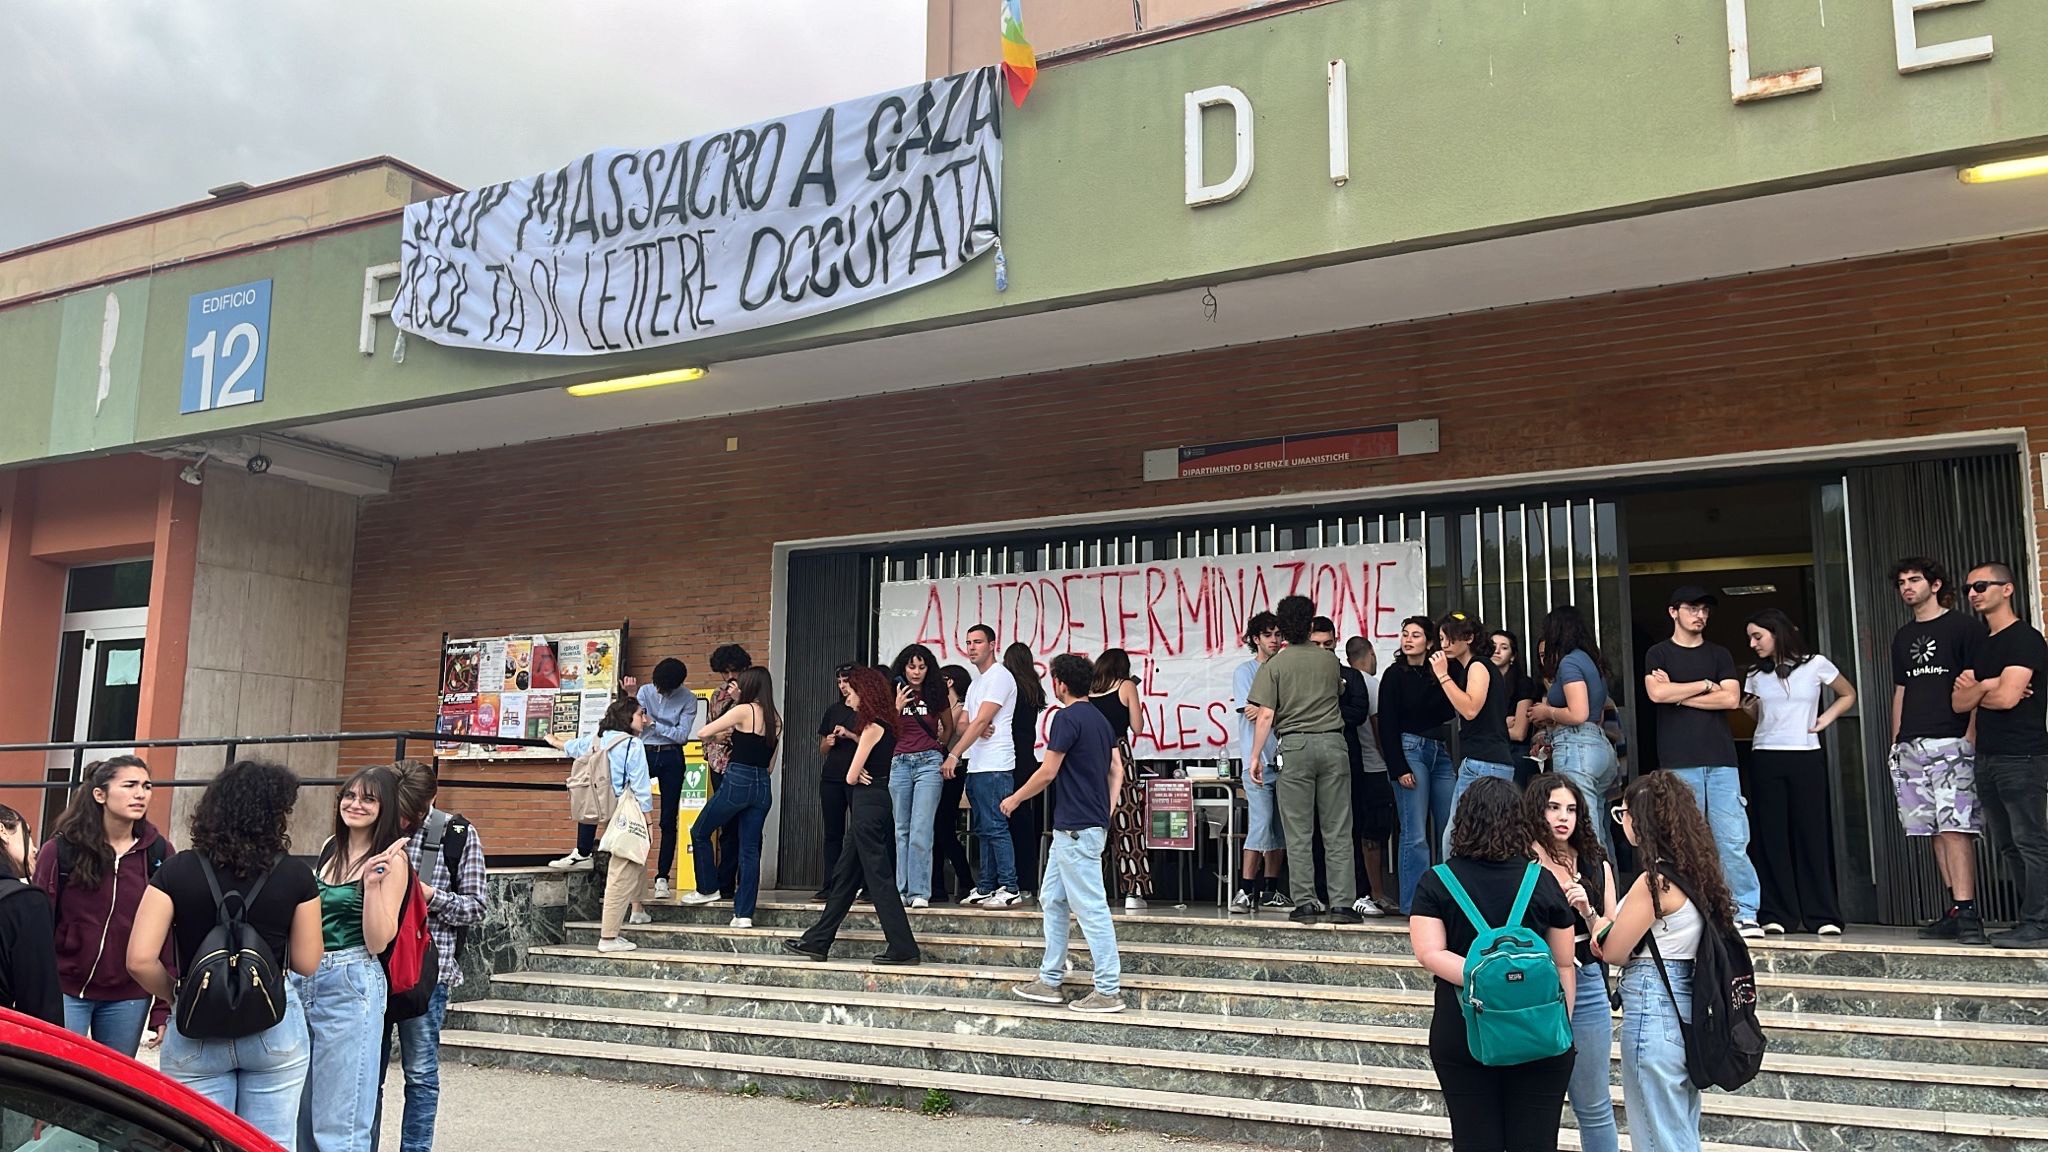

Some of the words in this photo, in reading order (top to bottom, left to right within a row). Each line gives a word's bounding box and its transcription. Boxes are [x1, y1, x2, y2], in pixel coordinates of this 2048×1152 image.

[517, 122, 787, 251] MASSACRO
[789, 107, 836, 207] A
[865, 65, 1000, 181] GAZA
[1185, 58, 1349, 207] DI
[579, 230, 718, 350] LETTERE
[739, 145, 998, 310] OCCUPATA
[202, 288, 256, 314] EDIFICIO
[191, 321, 260, 410] 12
[1182, 464, 1241, 477] DIPARTIMENTO
[1243, 462, 1252, 471] DI
[1254, 459, 1289, 470] SCIENZE
[1291, 452, 1350, 466] UMANISTICHE
[1143, 658, 1169, 697] IL
[686, 790, 702, 798] DAE
